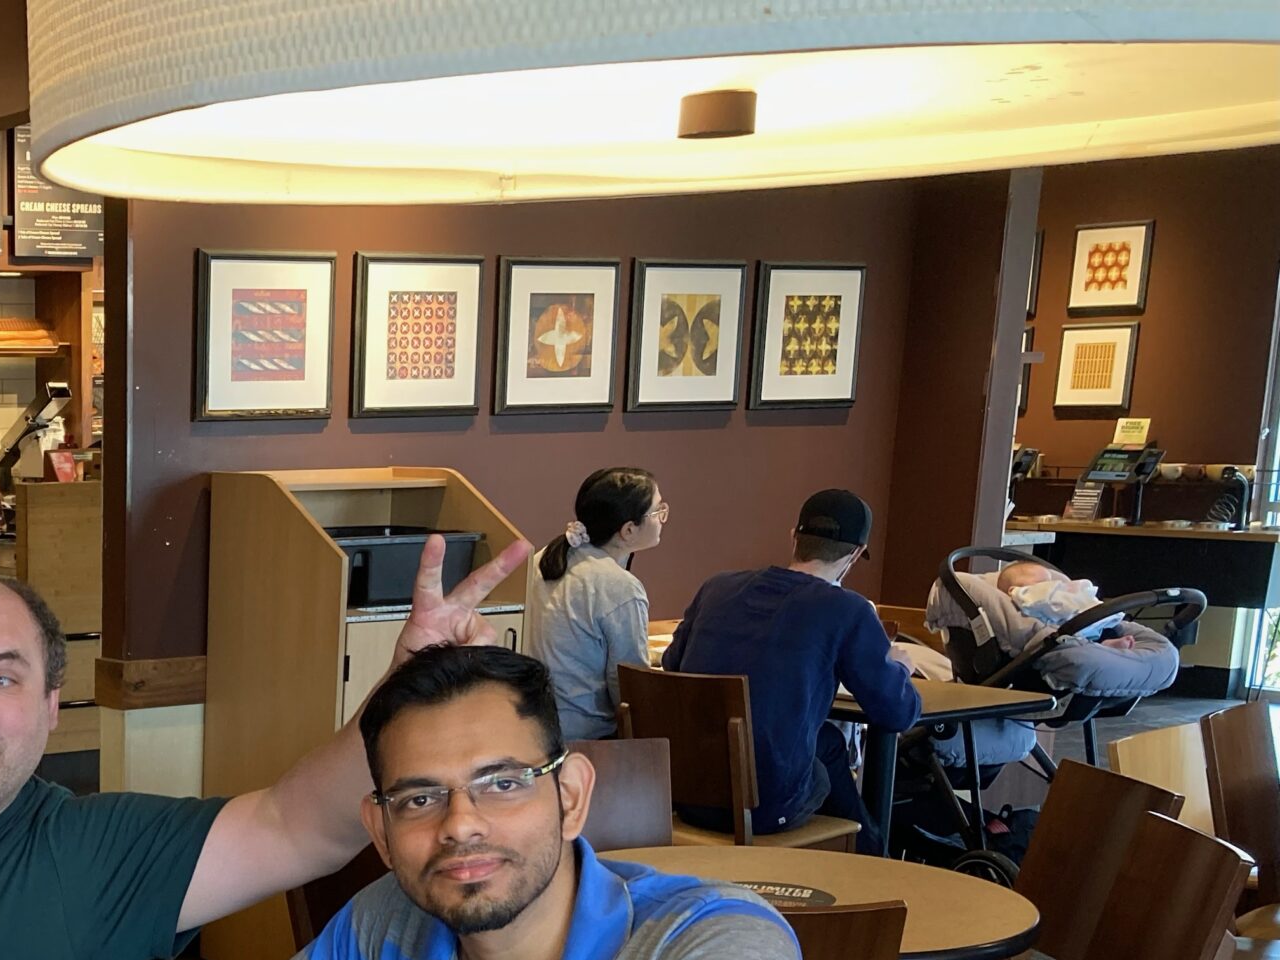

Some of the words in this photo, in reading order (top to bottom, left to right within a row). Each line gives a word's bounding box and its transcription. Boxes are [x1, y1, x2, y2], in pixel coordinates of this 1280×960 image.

[20, 201, 44, 212] CREAM
[46, 202, 71, 213] CHEESE
[72, 203, 102, 214] SPREADS
